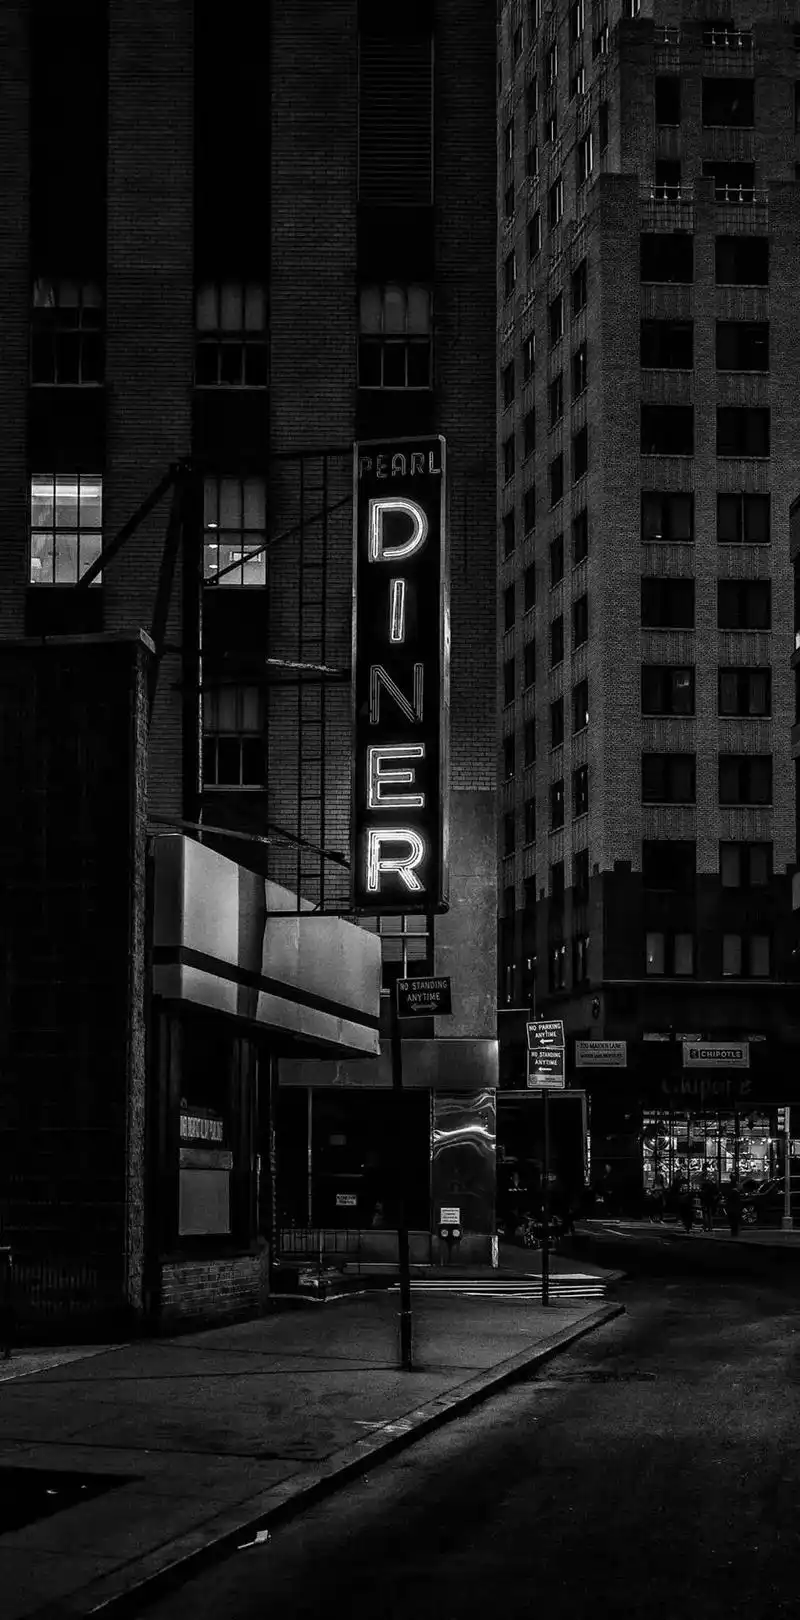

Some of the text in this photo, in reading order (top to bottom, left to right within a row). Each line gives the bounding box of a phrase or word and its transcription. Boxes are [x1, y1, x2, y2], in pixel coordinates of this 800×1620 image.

[359, 450, 441, 479] PEARL
[366, 496, 429, 893] DINER
[400, 980, 448, 991] NO STANDING
[407, 992, 441, 1002] ANYTIME
[538, 1023, 561, 1031] PARKING
[701, 1050, 742, 1058] CHIPOTLE
